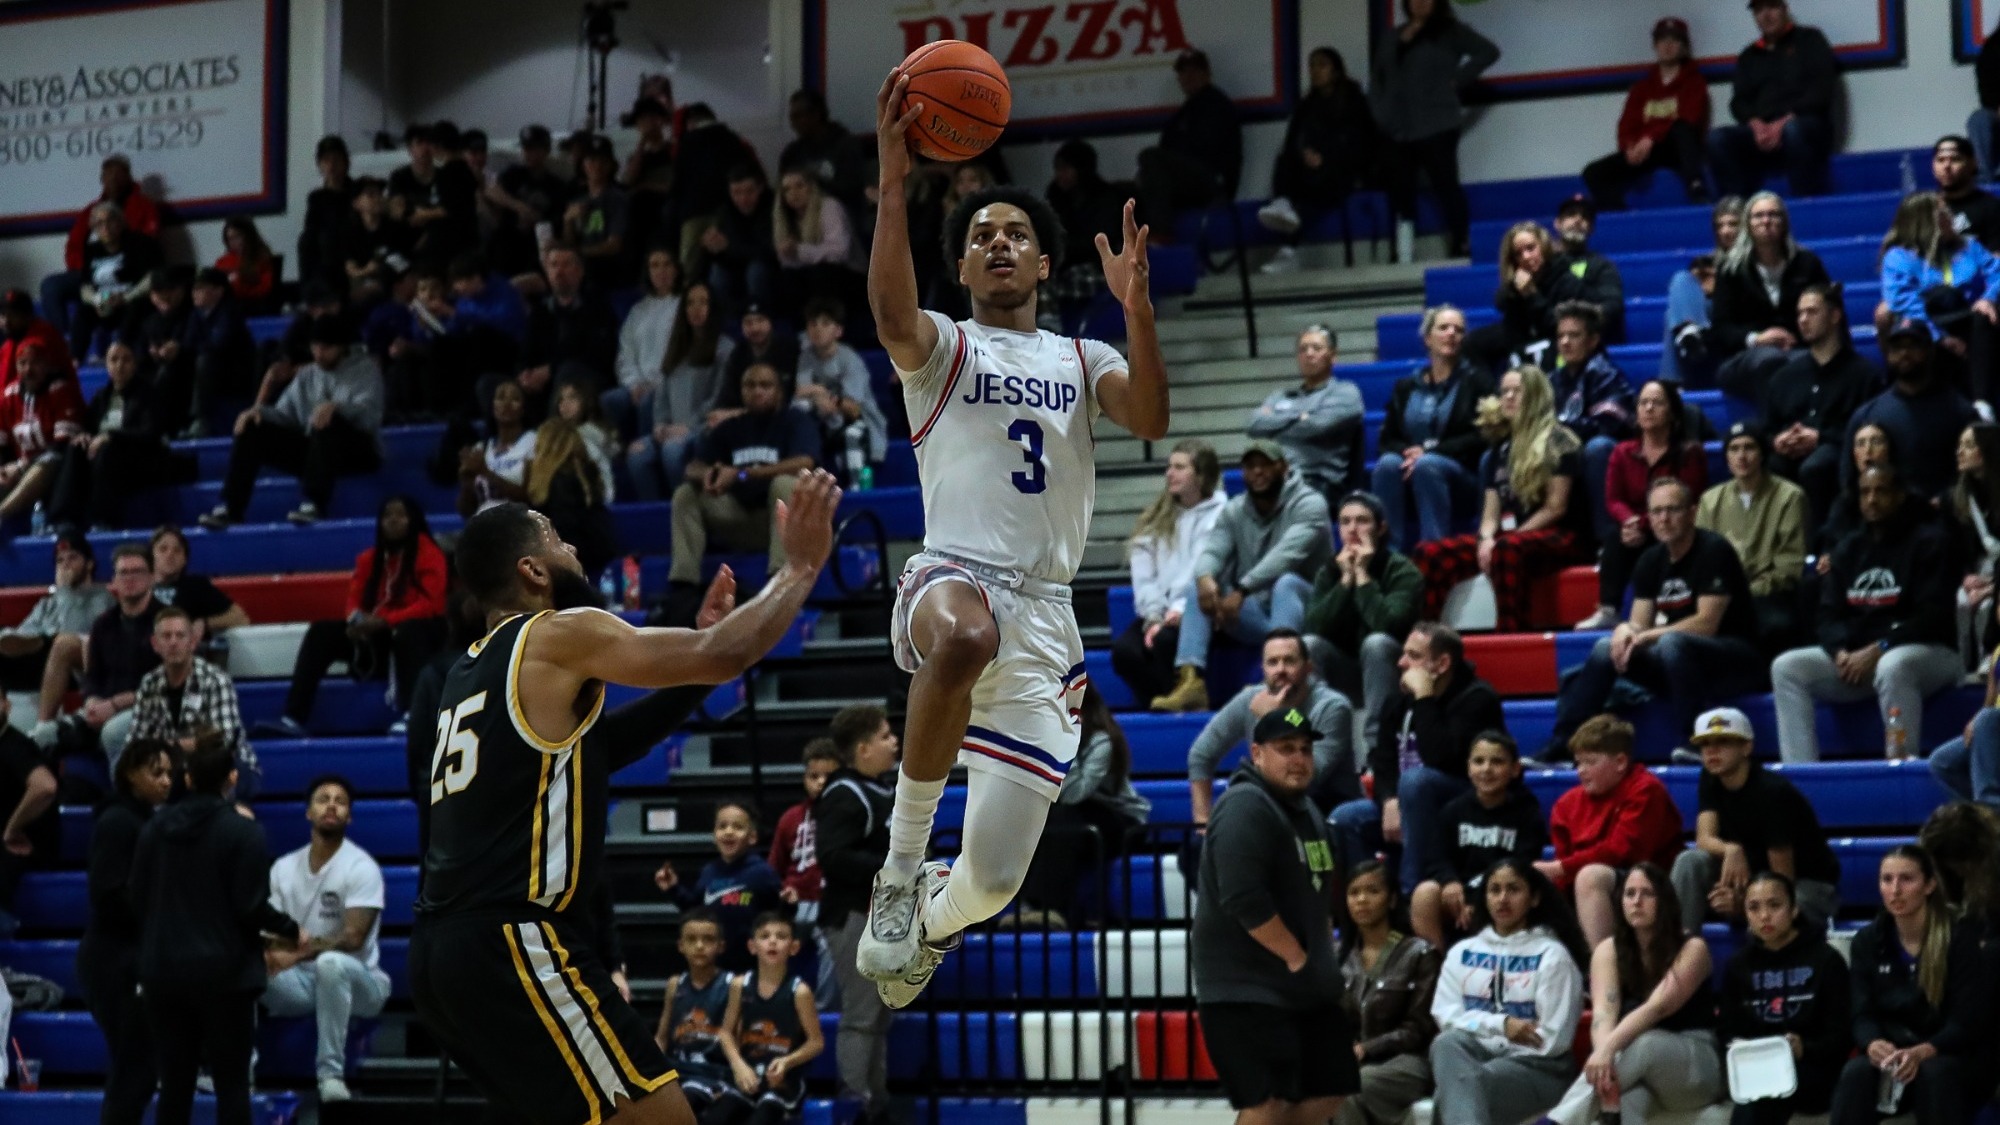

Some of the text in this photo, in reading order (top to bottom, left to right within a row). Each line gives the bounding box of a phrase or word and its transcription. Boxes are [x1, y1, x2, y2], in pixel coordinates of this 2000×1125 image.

[900, 0, 1192, 68] PIZZA
[85, 96, 192, 121] LAWYERS
[963, 373, 1076, 413] JESSUP
[1008, 419, 1046, 494] 3
[431, 689, 487, 806] 25
